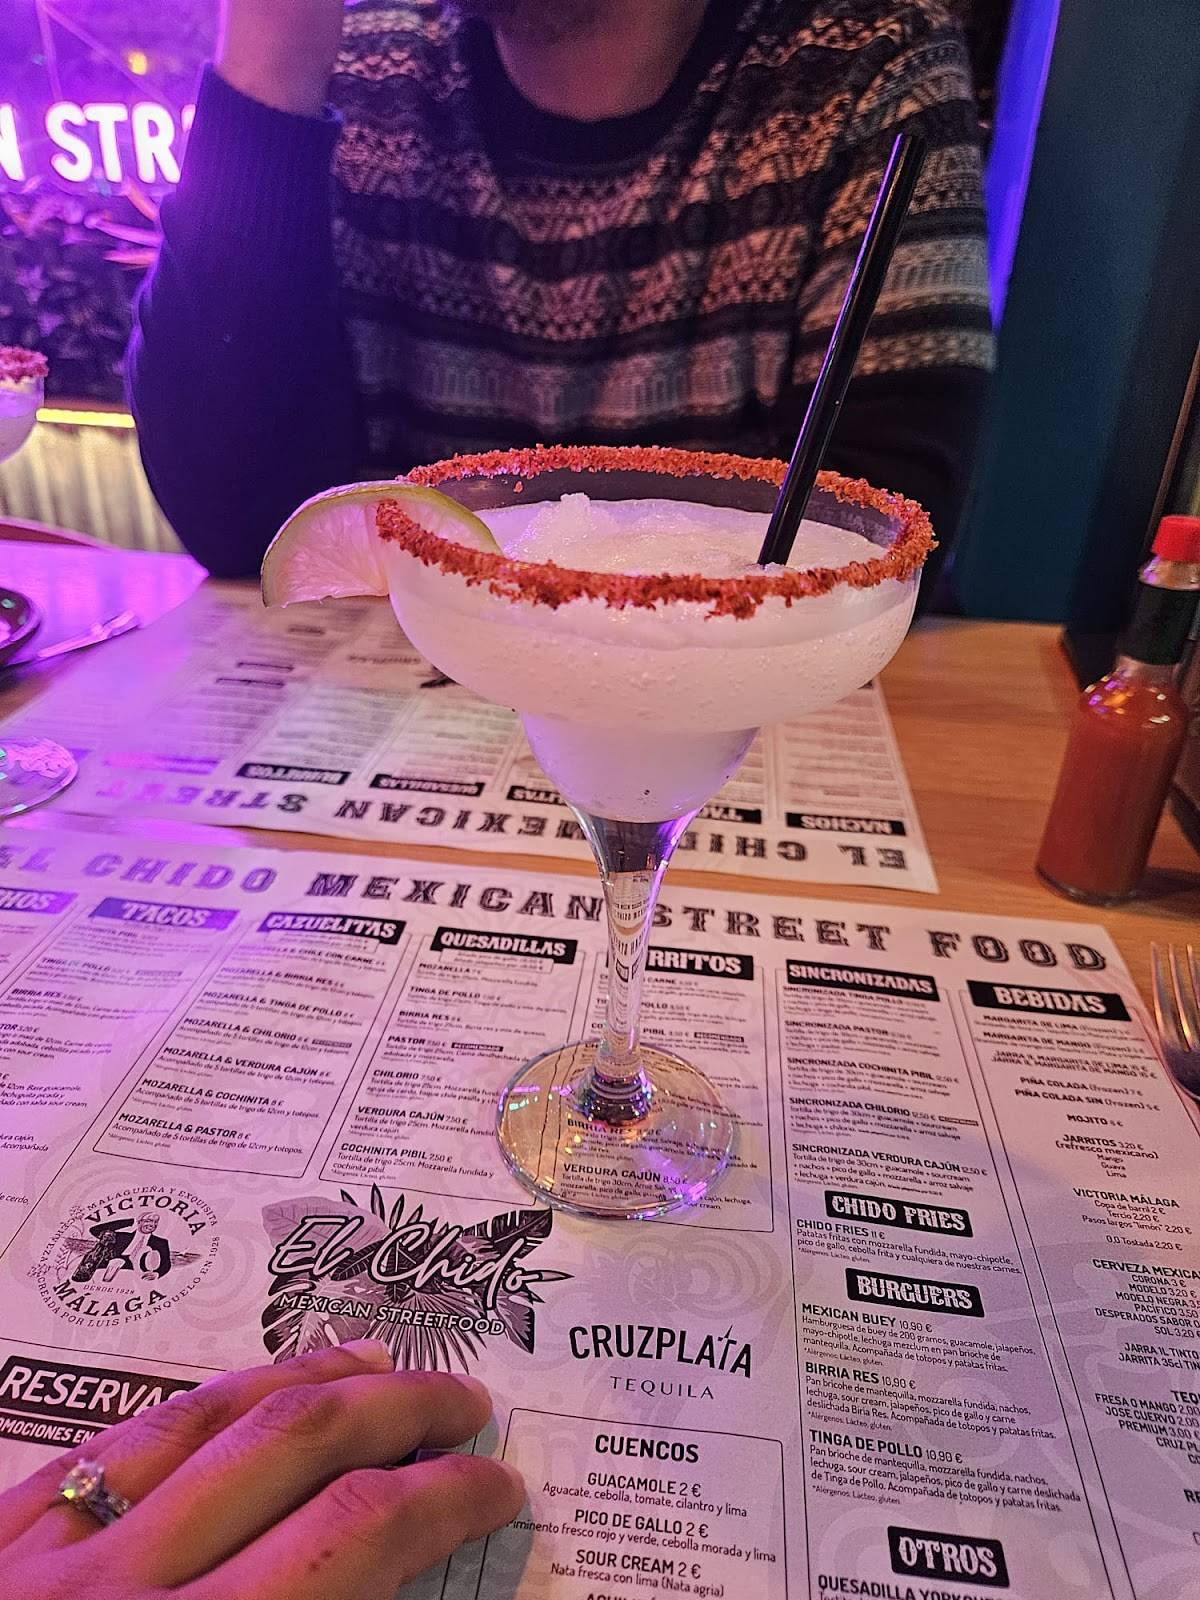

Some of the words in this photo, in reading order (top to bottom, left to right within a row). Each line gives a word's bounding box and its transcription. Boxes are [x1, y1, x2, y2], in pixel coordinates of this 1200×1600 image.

[45, 101, 196, 183] STR
[698, 807, 742, 822] TAC
[801, 816, 892, 834] NACHOS
[681, 832, 807, 861] CHID
[837, 844, 908, 869] EL
[83, 854, 277, 893] CHIDO
[305, 873, 603, 922] MEXICAN
[652, 903, 890, 951] STREET
[928, 931, 1106, 970] FOOD
[122, 901, 212, 927] TACOS
[267, 916, 396, 939] CAZUELITAS
[440, 932, 566, 956] QUESADILLAS
[648, 950, 742, 974] RRITOS
[789, 964, 933, 993] SINCRONIZADAS
[993, 987, 1107, 1014] BEBIDAS
[142, 1078, 203, 1097] MOZARELLA
[215, 1092, 270, 1106] COCHINITA
[119, 1113, 182, 1131] MOZARELLA
[184, 1125, 193, 1133] &
[194, 1127, 237, 1138] PASTOR
[357, 1106, 406, 1118] VERDURA
[1067, 1114, 1108, 1125] MOJITO
[341, 1143, 398, 1157] COCHINITA
[400, 1149, 427, 1159] PIBIL
[1063, 1135, 1117, 1147] JARRITOS
[792, 1144, 870, 1159] SINCRONIZADA
[872, 1152, 923, 1167] VERDURA
[1073, 1188, 1128, 1202] VICTORIA
[1130, 1194, 1180, 1208] MÁLAGA
[86, 1195, 206, 1236] VICTORIA
[832, 1195, 897, 1221] CHIDO
[903, 1205, 966, 1231] FRIES
[797, 1219, 833, 1231] CHIDO
[835, 1223, 869, 1237] FRIES
[879, 1232, 885, 1240] €
[268, 1215, 364, 1275] El
[369, 1221, 543, 1311] Chido
[1092, 1259, 1150, 1274] CERVEZA
[857, 1275, 973, 1309] BURGUERS
[1129, 1284, 1167, 1295] MODELO
[1132, 1275, 1170, 1286] CORONA
[53, 1280, 167, 1317] MÁLAGA
[60, 1312, 84, 1326] POR
[87, 1319, 120, 1327] LUIS
[279, 1294, 371, 1318] MEXICAN
[376, 1306, 506, 1335] STREETFOOD
[802, 1303, 859, 1322] MEXICAN
[863, 1313, 896, 1327] BUEY
[925, 1323, 933, 1333] €
[802, 1316, 855, 1332] Hamburguesa
[868, 1326, 887, 1338] buey
[889, 1329, 898, 1337] de
[900, 1331, 915, 1341] 200
[569, 1324, 751, 1378] CRUZPLATA
[852, 1344, 902, 1360] Acompañada
[904, 1351, 914, 1359] de
[916, 1352, 947, 1366] totopos
[955, 1357, 984, 1372] patatas
[861, 1333, 892, 1348] lechuga
[893, 1340, 930, 1352] mezclum
[931, 1344, 941, 1353] en
[943, 1347, 958, 1358] pan
[960, 1347, 989, 1359] brioche
[991, 1351, 1000, 1361] de
[610, 1376, 715, 1400] TEQUILA
[805, 1362, 851, 1379] BIRRIA
[853, 1369, 880, 1384] RES
[909, 1379, 916, 1389] €
[1095, 1393, 1130, 1408] FRESA
[1139, 1400, 1177, 1414] MANGO
[1105, 1406, 1133, 1418] JOSE
[1134, 1410, 1176, 1425] CUERVO
[595, 1434, 699, 1464] CUENCOS
[809, 1429, 853, 1448] TINGA
[855, 1437, 873, 1451] DE
[877, 1440, 923, 1458] POLLO
[955, 1453, 963, 1464] €
[588, 1472, 676, 1495] GUACAMOLE
[679, 1482, 688, 1496] 2
[692, 1484, 702, 1498] €
[543, 1482, 591, 1498] Aguacate,
[594, 1489, 632, 1503] cebolla,
[635, 1493, 674, 1508] tomate,
[676, 1499, 714, 1513] cilantro
[715, 1505, 723, 1516] y
[725, 1503, 747, 1517] lima
[575, 1509, 609, 1525] PICO
[612, 1513, 632, 1528] DE
[635, 1516, 683, 1535] GALLO
[686, 1522, 695, 1537] 2
[699, 1524, 709, 1538] €
[562, 1523, 594, 1538] fresco
[597, 1528, 616, 1542] rojo
[618, 1533, 625, 1544] y
[627, 1531, 659, 1547] verde,
[662, 1536, 699, 1552] cebolla
[701, 1542, 742, 1558] morada
[745, 1550, 751, 1561] y
[753, 1547, 776, 1562] lima
[575, 1549, 617, 1567] SOUR
[621, 1555, 674, 1575] CREAM
[678, 1562, 687, 1577] 2
[692, 1564, 702, 1579] €
[899, 1536, 998, 1578] OTROS
[551, 1563, 576, 1577] Nata
[578, 1566, 611, 1582] fresca
[614, 1572, 633, 1584] con
[635, 1572, 659, 1588] lima
[661, 1575, 691, 1592] (Nata
[693, 1583, 724, 1599] agria)
